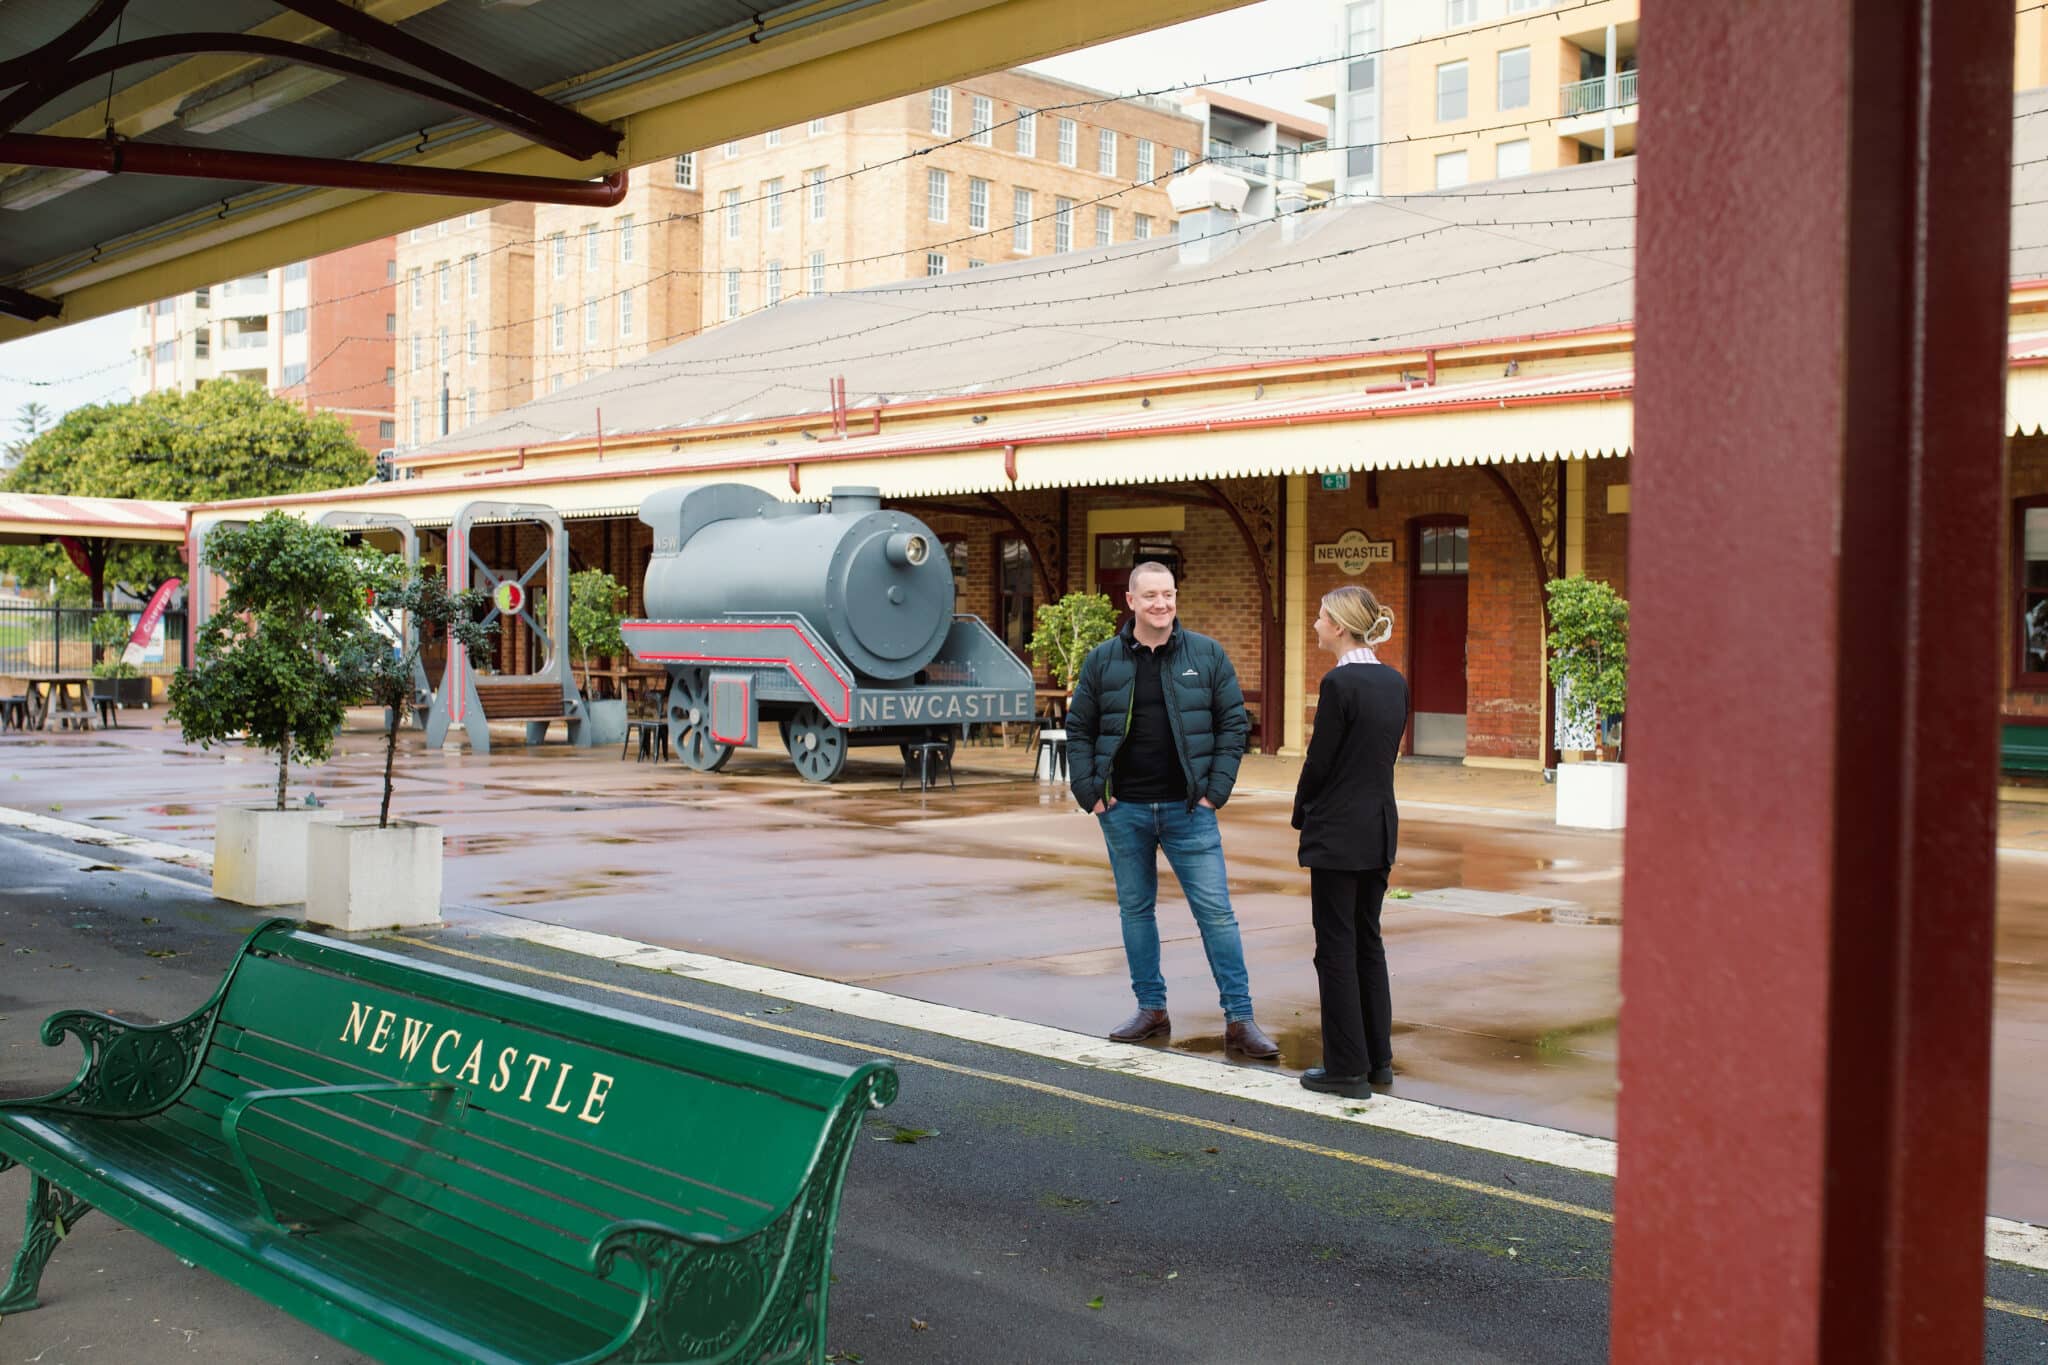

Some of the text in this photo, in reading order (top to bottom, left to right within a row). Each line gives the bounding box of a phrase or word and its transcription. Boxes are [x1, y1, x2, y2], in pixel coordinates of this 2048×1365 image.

[1318, 546, 1389, 560] NEWCASTLE
[859, 693, 1028, 721] NEWCASTLE
[340, 1001, 614, 1124] NEWCASTLE
